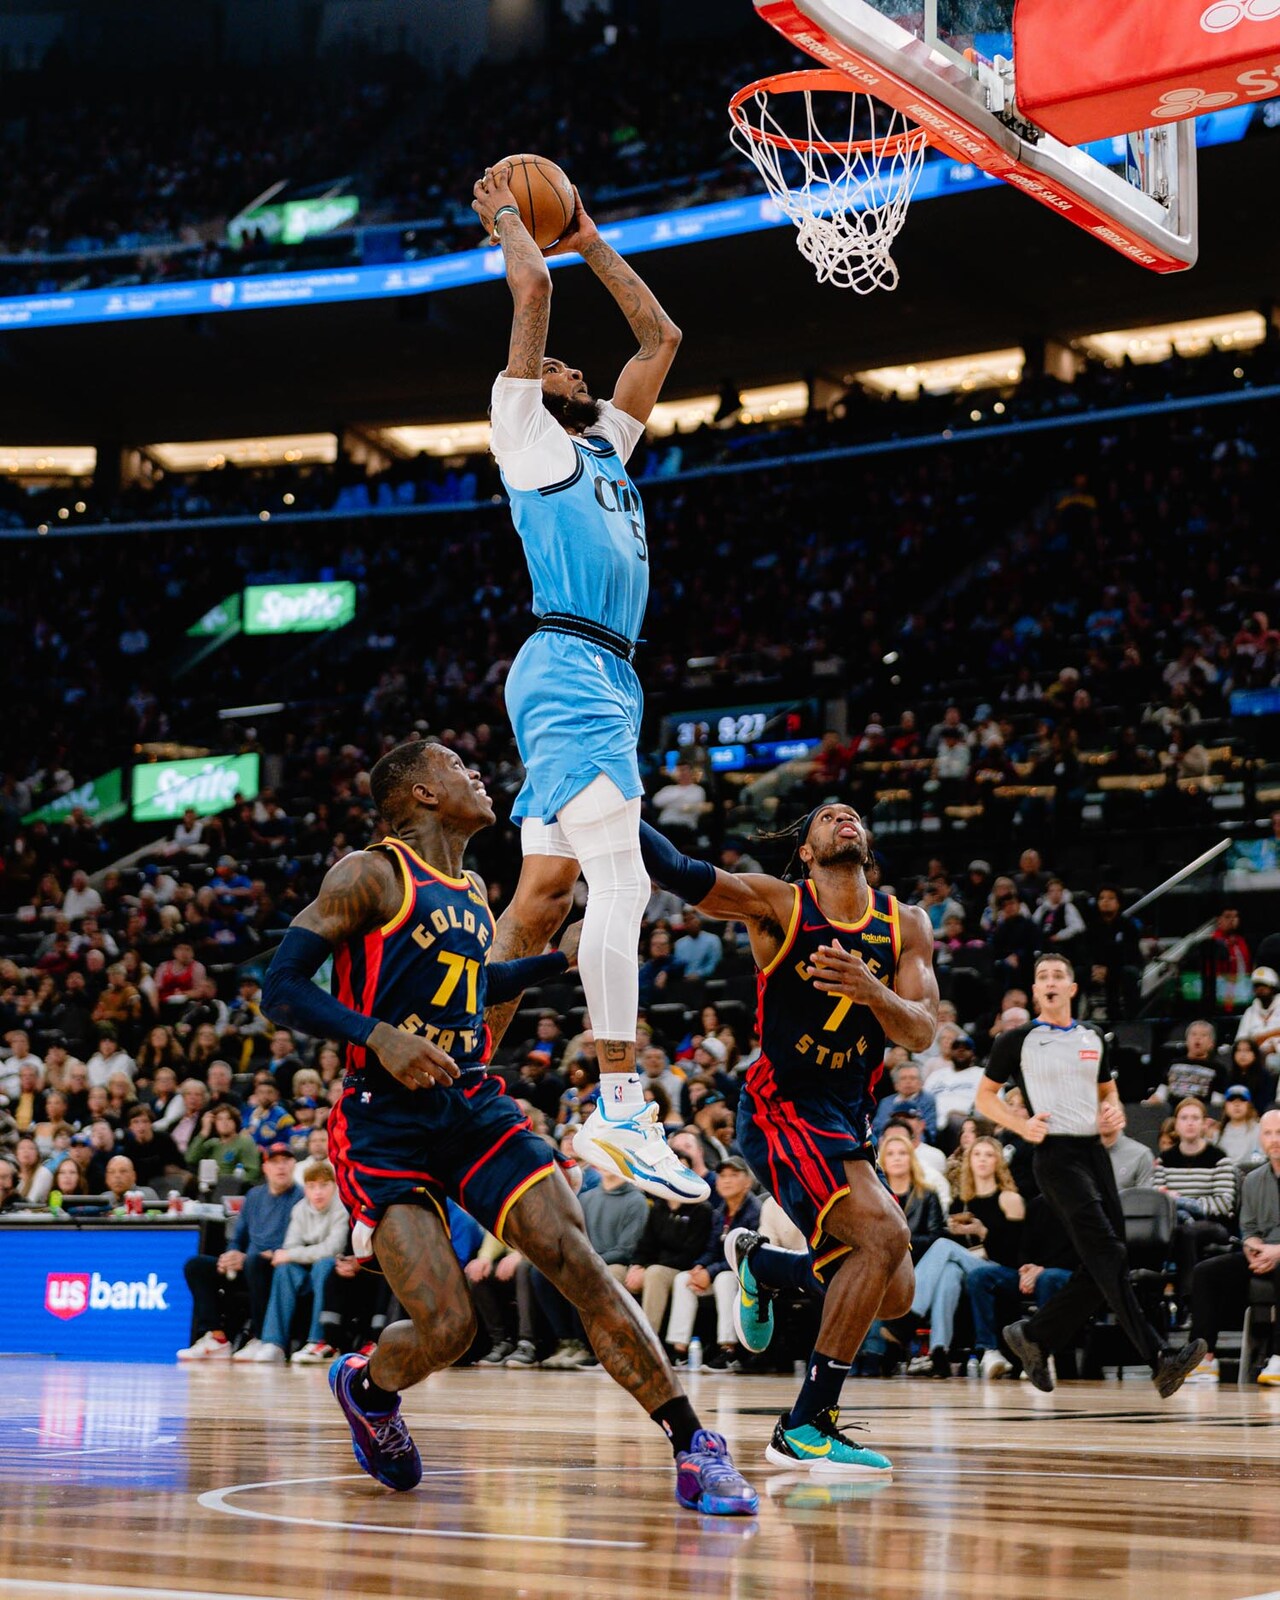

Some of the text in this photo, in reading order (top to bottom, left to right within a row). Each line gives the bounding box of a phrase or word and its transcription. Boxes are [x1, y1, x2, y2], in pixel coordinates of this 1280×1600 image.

[792, 32, 880, 85] HERDEZ SALSA
[906, 104, 983, 154] HERDEZ SALSA
[1004, 173, 1073, 211] HERDEZ SALSA
[1091, 226, 1157, 264] HERDEZ SALSA
[256, 588, 343, 629] Sprite
[152, 763, 240, 812] Sprite
[861, 932, 891, 944] Rakuten
[431, 950, 480, 1015] 71
[822, 990, 853, 1032] 7
[48, 1272, 168, 1310] us bank
